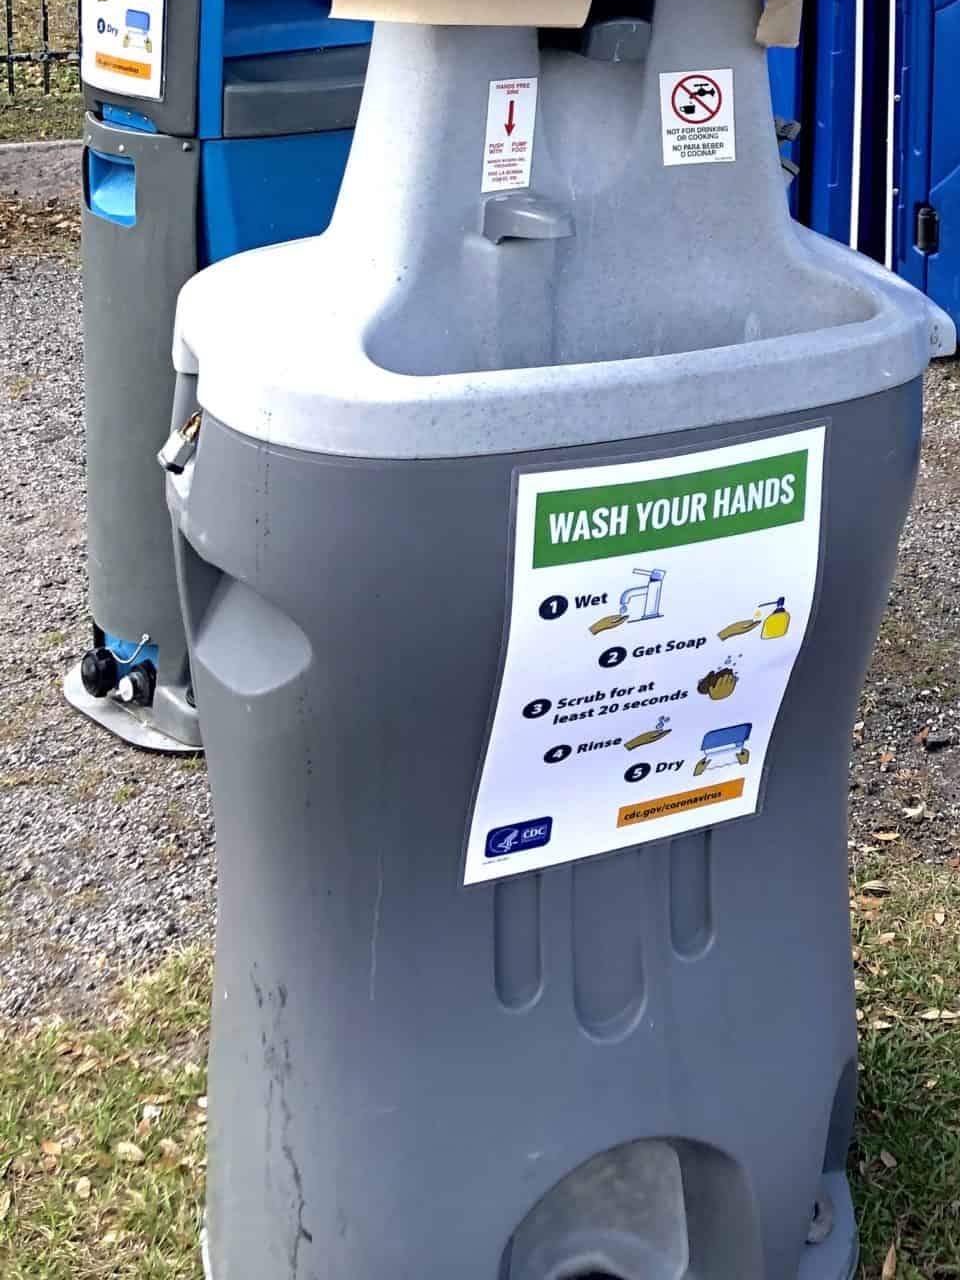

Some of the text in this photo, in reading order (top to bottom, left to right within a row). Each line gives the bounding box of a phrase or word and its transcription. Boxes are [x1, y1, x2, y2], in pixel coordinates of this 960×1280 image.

[688, 132, 719, 140] COOKING
[696, 125, 728, 133] DRINKING
[672, 144, 682, 152] NO
[687, 149, 716, 157] COCINAR
[549, 473, 797, 545] WASH YOUR HANDS
[549, 593, 609, 615] 1 Wet
[606, 636, 707, 664] 2 Get Soap
[531, 681, 656, 715] 3 Scrub for at
[552, 689, 689, 726] least 20 seconds
[551, 737, 623, 760] 4 Rinse
[631, 759, 685, 778] 5 Dry
[623, 791, 722, 821] cdc.gov/coronavirus
[523, 826, 545, 838] CDC
